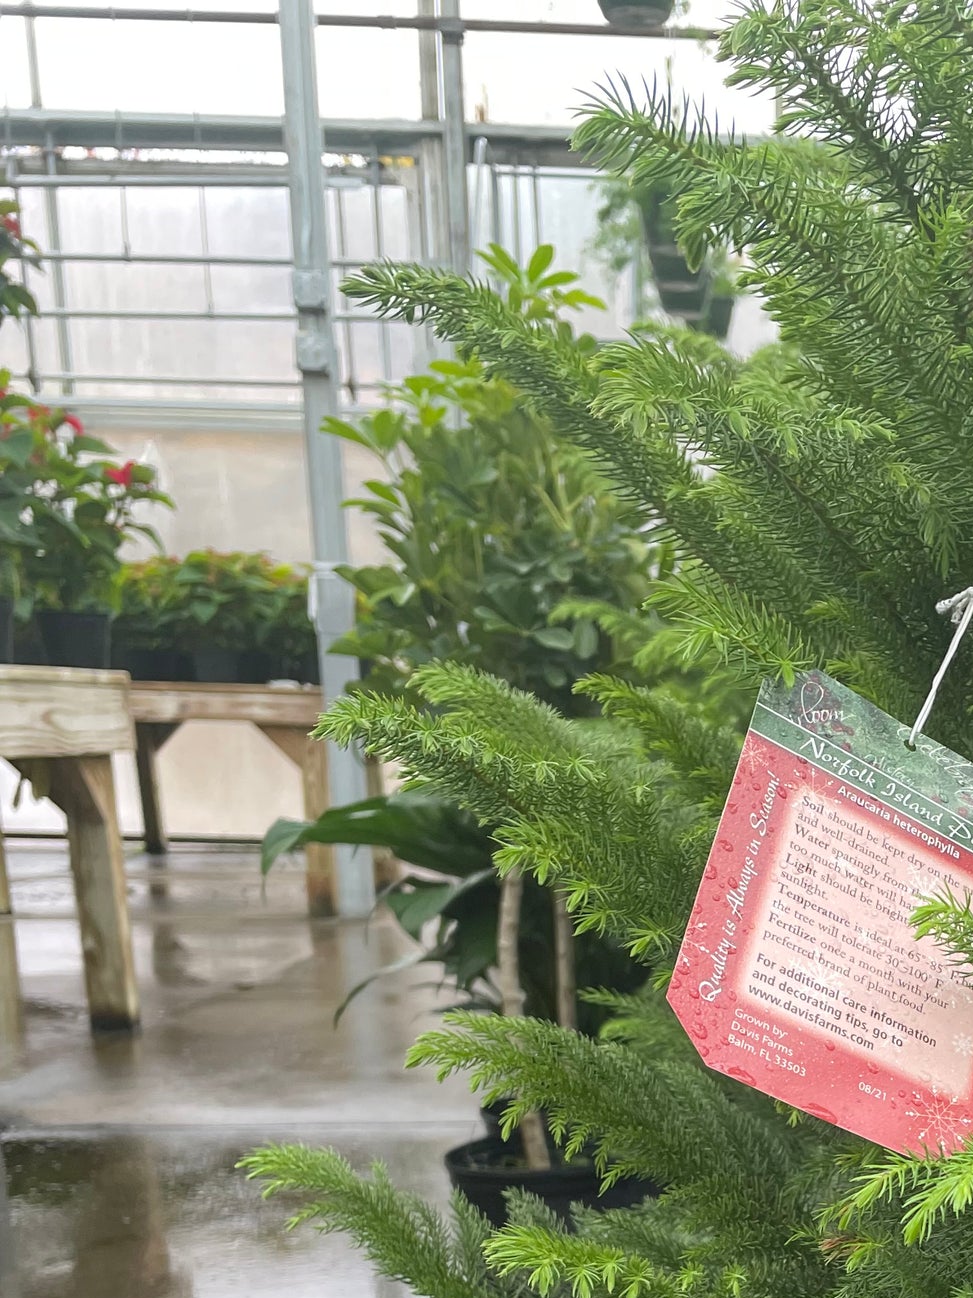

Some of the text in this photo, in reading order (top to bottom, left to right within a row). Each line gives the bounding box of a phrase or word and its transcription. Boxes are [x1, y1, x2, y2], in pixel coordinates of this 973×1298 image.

[800, 738, 876, 788] Norfolk
[881, 783, 943, 826] Island
[795, 823, 830, 850] Water
[832, 847, 880, 879] sparingly
[883, 872, 908, 892] from
[798, 812, 890, 867] and well-drained.
[802, 796, 824, 815] Soil
[828, 812, 864, 836] should
[866, 830, 879, 844] be
[882, 838, 905, 859] kept
[907, 854, 926, 870] dry
[928, 867, 941, 879] on
[944, 874, 960, 888] the
[838, 786, 961, 859] Araucaria heterophylla
[698, 771, 780, 1002] Quality is Always in Season!
[780, 870, 828, 900] sunlight.
[786, 853, 818, 877] Light
[821, 873, 857, 898] should
[860, 892, 873, 906] be
[790, 841, 807, 856] too
[811, 853, 840, 872] much
[845, 869, 874, 890] water
[877, 887, 897, 901] will
[772, 899, 790, 914] the
[794, 910, 815, 926] tree
[818, 922, 839, 938] will
[841, 933, 883, 960] tolerate
[935, 978, 945, 991] F.
[778, 882, 851, 928] Temperature
[855, 923, 863, 934] is
[866, 928, 892, 948] ideal
[895, 945, 905, 956] at
[763, 929, 926, 1015] preferred brand of plant food.
[768, 911, 949, 1009] Fertilize once a month with your
[734, 1008, 770, 1030] Grown
[748, 984, 875, 1051] www.davisfarms.com
[752, 969, 904, 1048] and decorating tips, go to
[756, 952, 937, 1048] For additional care information
[727, 1034, 807, 1077] Balm, FL 33503
[730, 1021, 794, 1057] Davis Farms
[858, 1081, 887, 1102] 08/21
